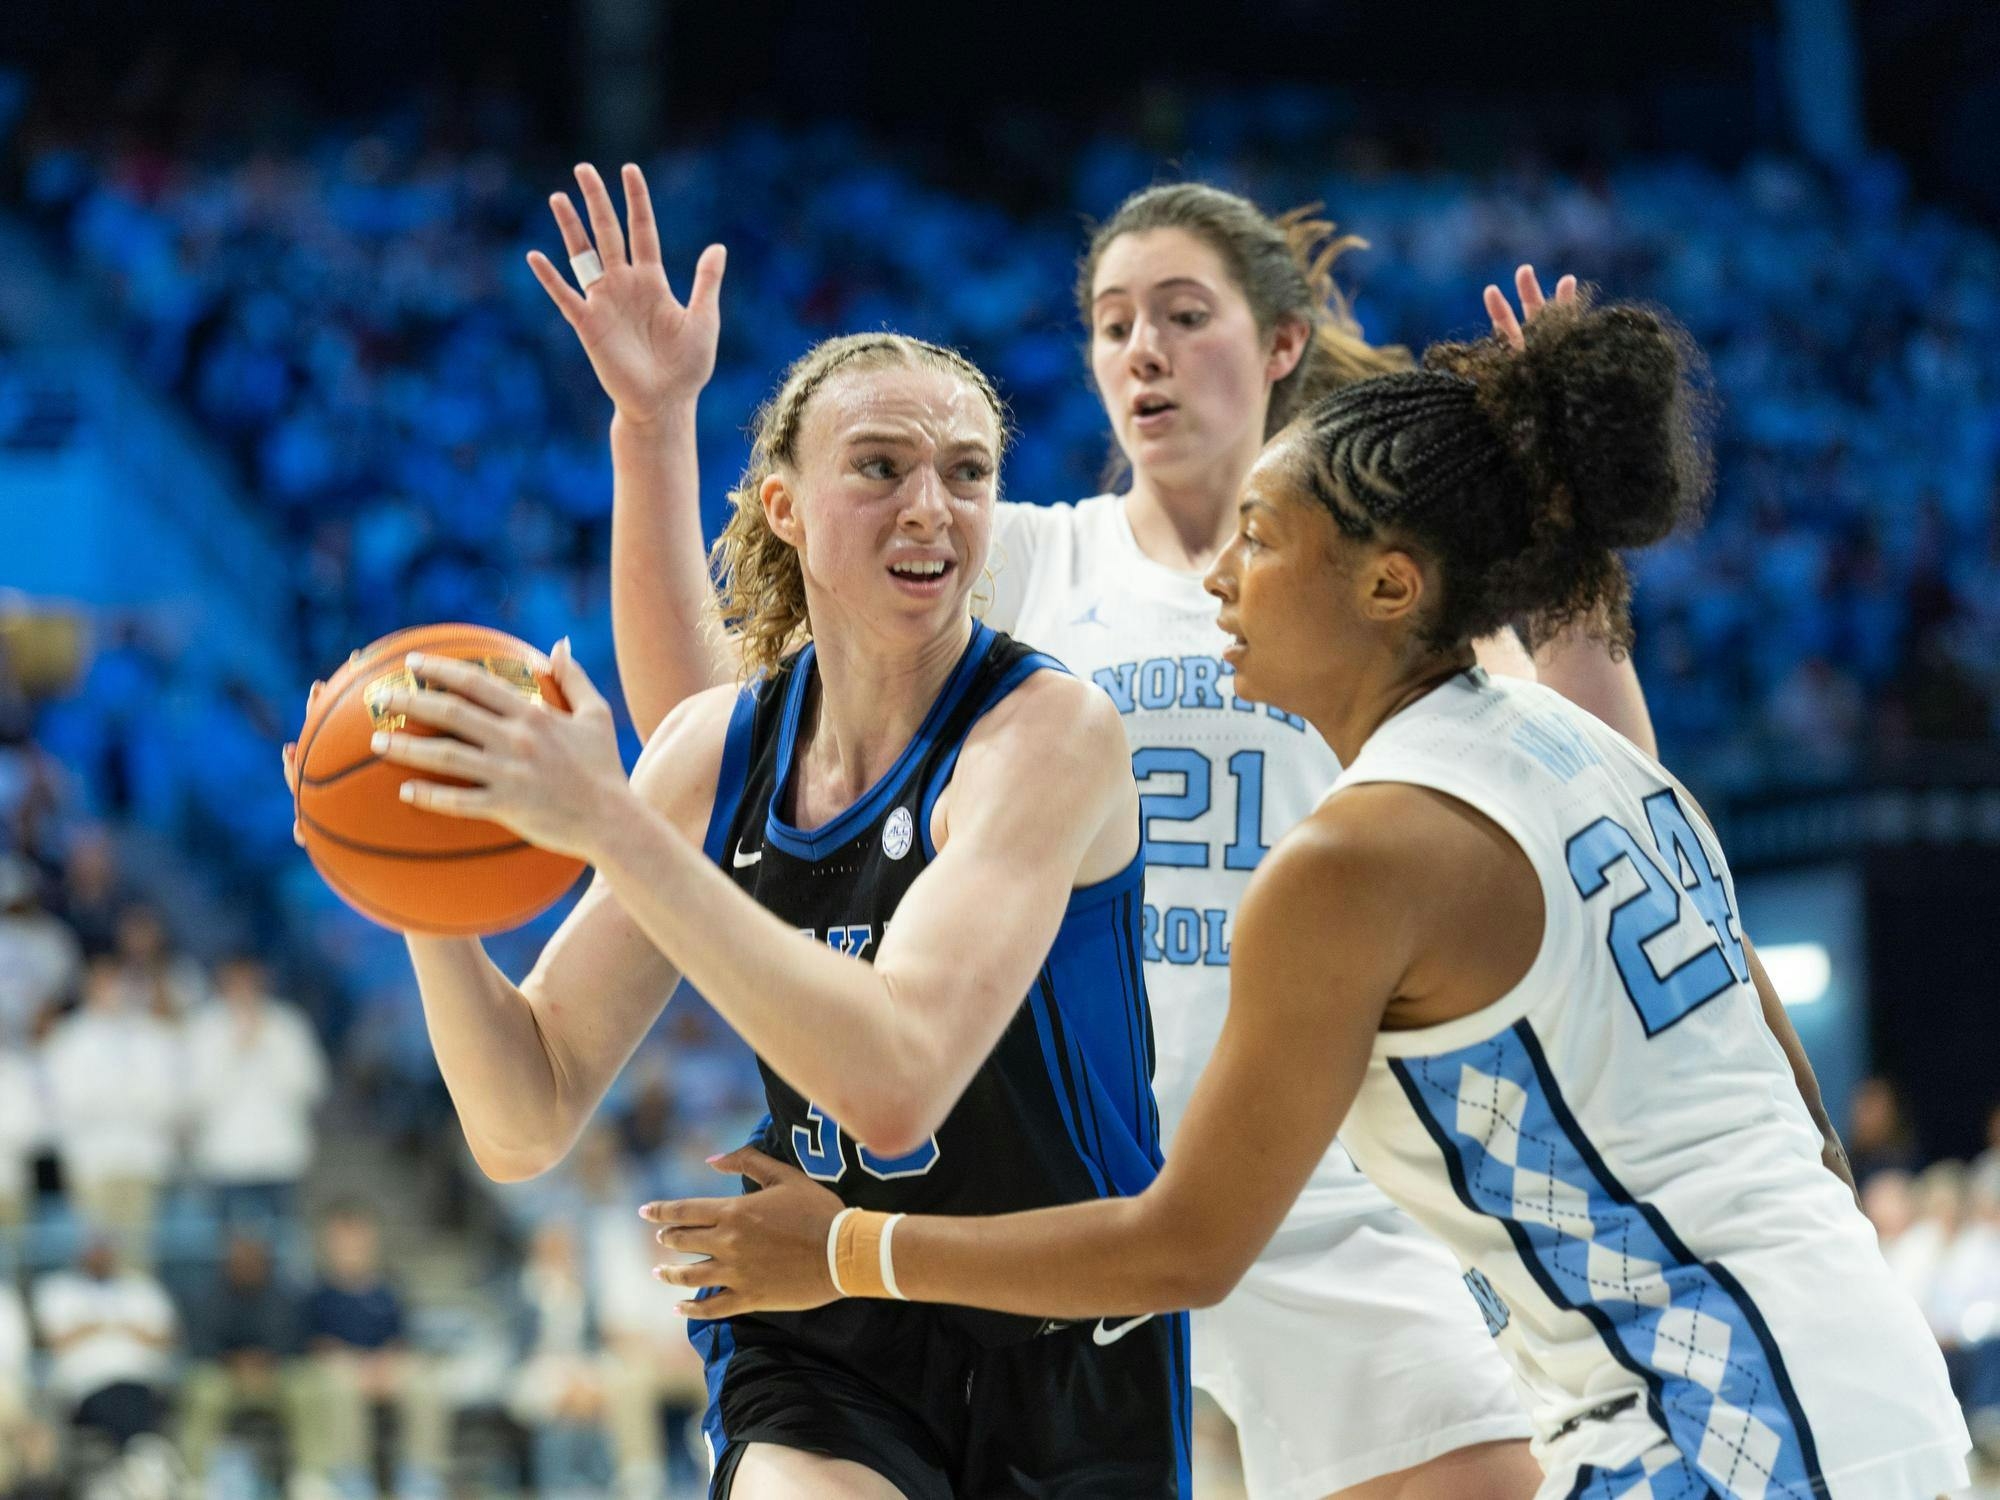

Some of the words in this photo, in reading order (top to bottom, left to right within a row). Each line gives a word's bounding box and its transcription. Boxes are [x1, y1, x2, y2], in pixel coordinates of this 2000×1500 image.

[1131, 747, 1271, 870] 21
[1566, 787, 1750, 1040] 24
[792, 1097, 940, 1183] 3
